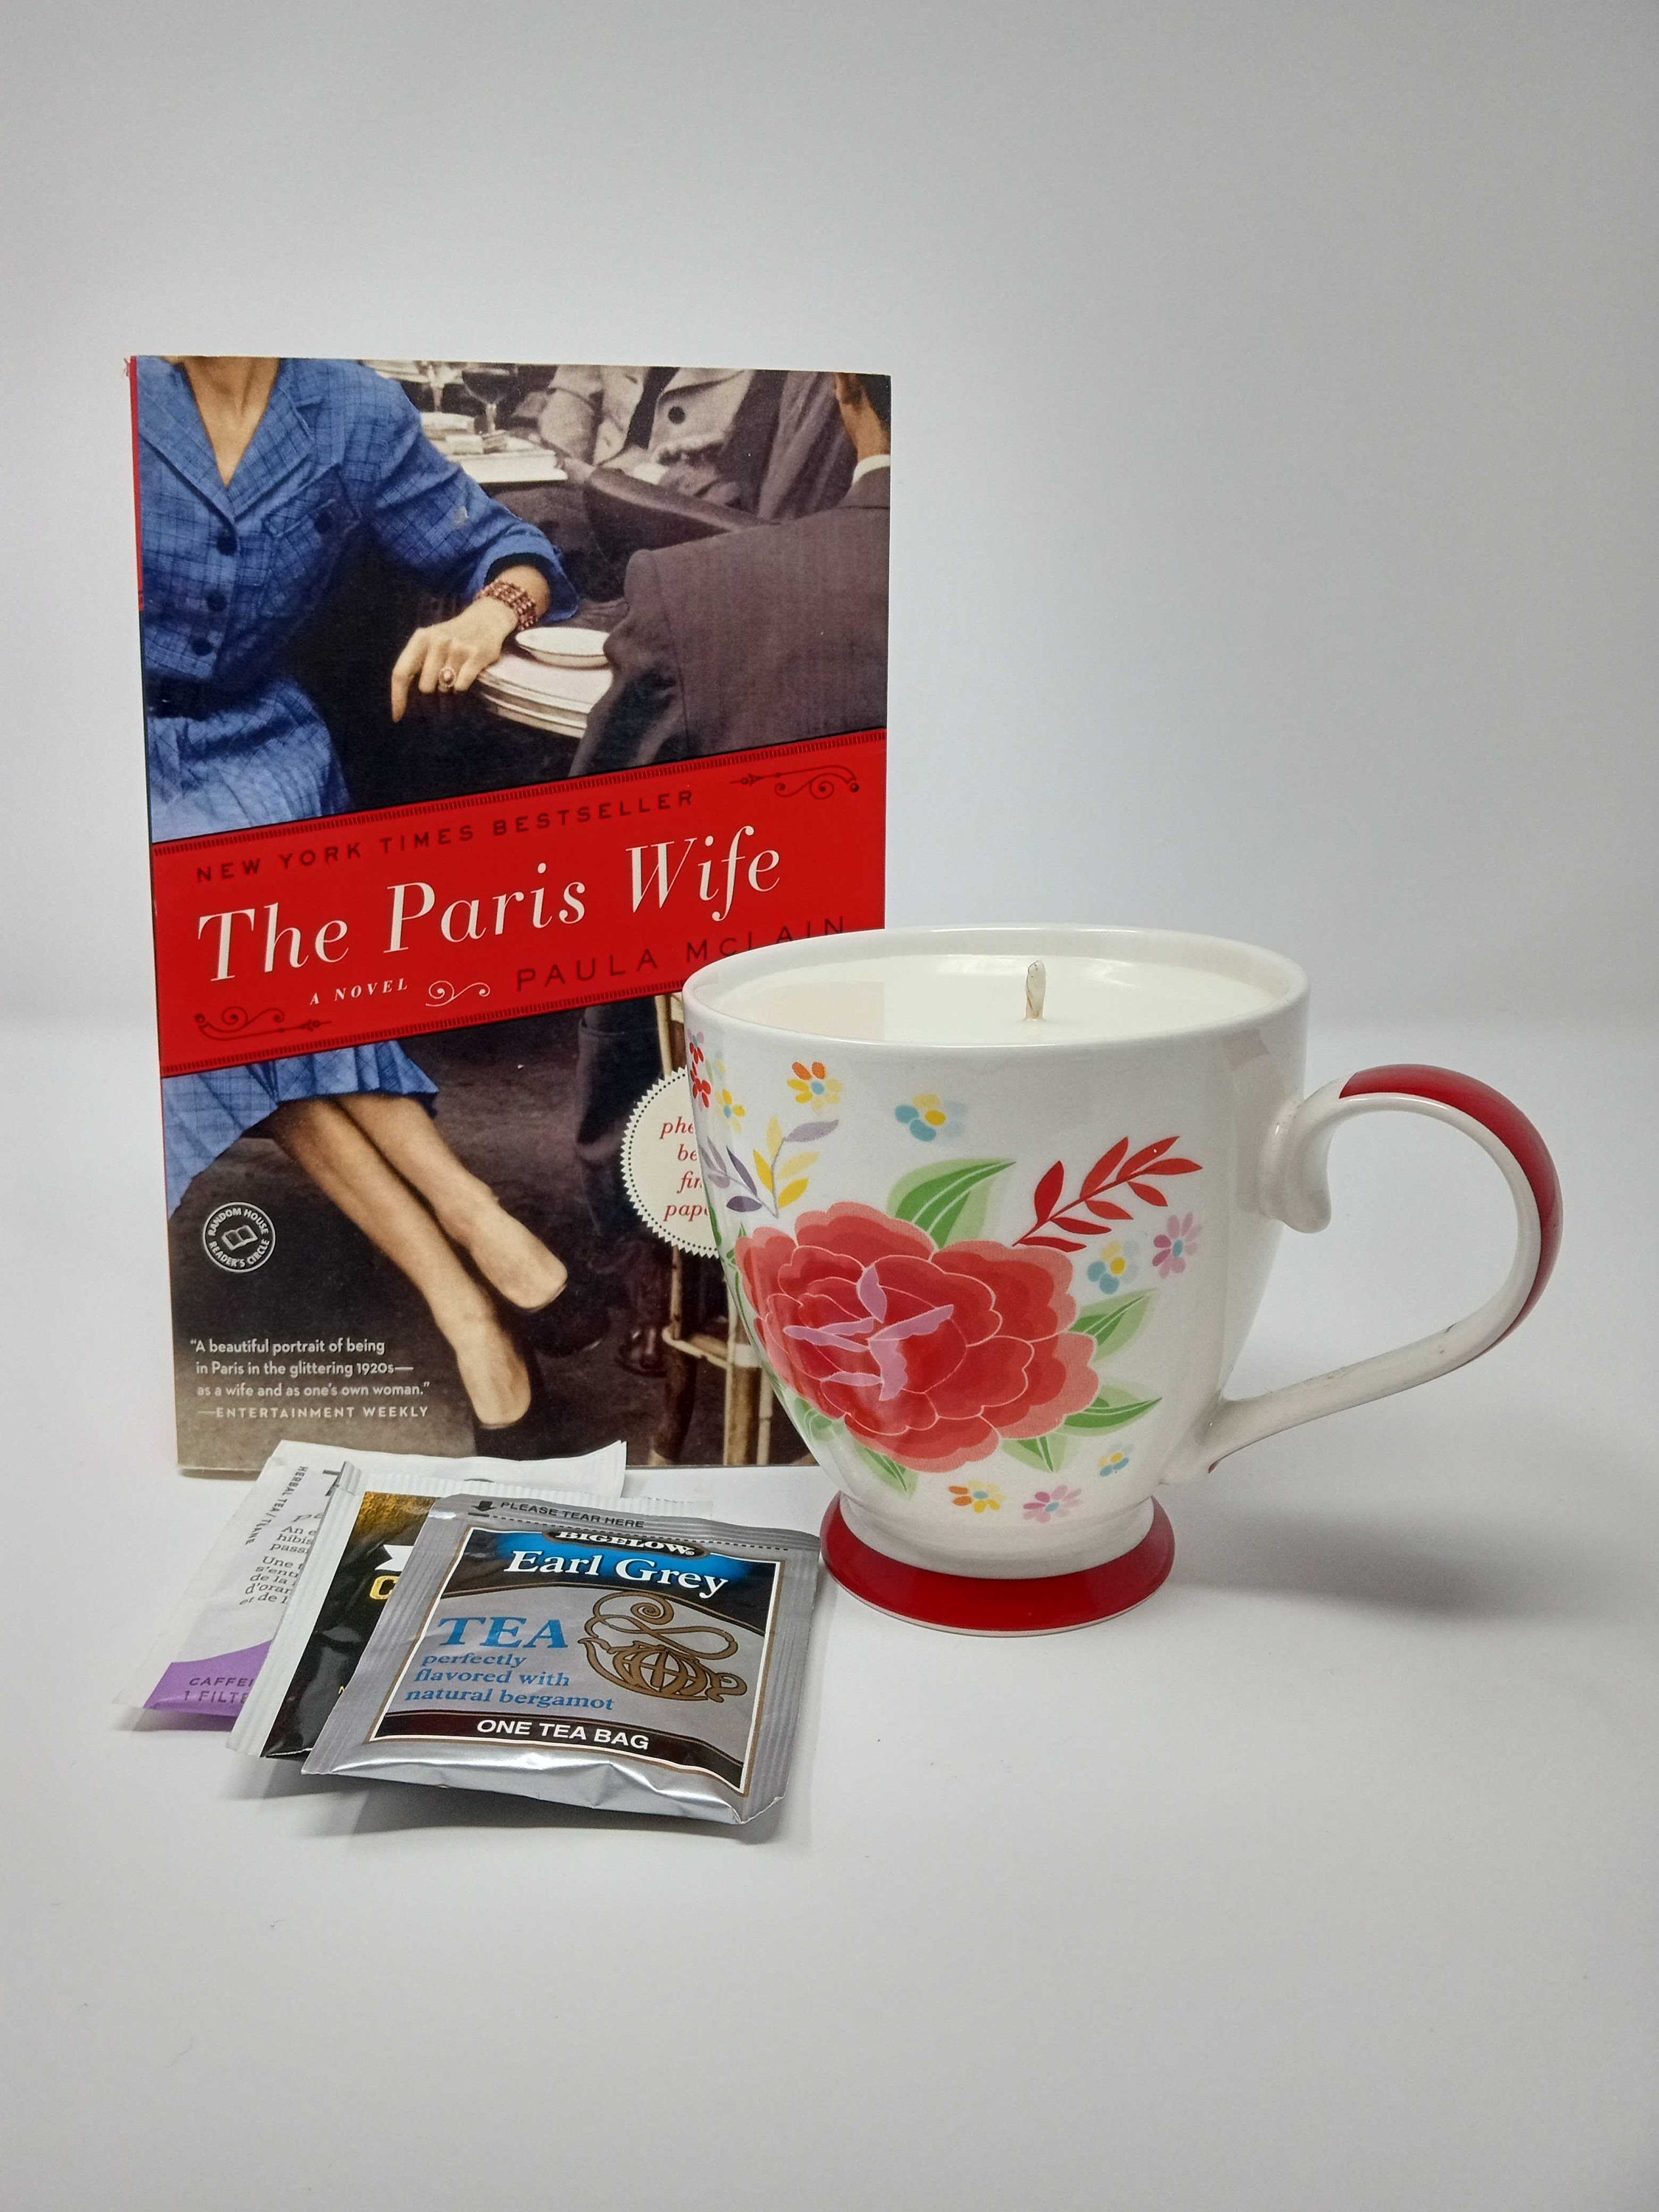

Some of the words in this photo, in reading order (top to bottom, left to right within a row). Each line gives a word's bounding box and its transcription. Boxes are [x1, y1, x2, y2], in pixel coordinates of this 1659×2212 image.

[197, 858, 261, 883] NEW
[279, 842, 361, 869] YORK
[380, 825, 475, 854] TIMES
[493, 790, 694, 836] BESTSELLER
[198, 902, 349, 981] The
[383, 863, 586, 954] Paris
[626, 825, 781, 922] Wife
[518, 949, 658, 991] PAULA
[310, 992, 320, 1006] A
[334, 978, 408, 1001] NOVEL
[208, 1208, 242, 1237] RANDOM
[243, 1209, 269, 1234] HOUSE
[209, 1241, 246, 1267] READER'S
[247, 1239, 270, 1265] CIRCLE
[209, 1338, 269, 1353] beautiful
[273, 1339, 325, 1356] portrait
[329, 1338, 344, 1352] of
[347, 1337, 385, 1355] being
[196, 1361, 208, 1374] in
[212, 1360, 245, 1374] Paris
[248, 1362, 260, 1374] in
[264, 1360, 286, 1374] the
[290, 1360, 353, 1378] glittering
[198, 1386, 211, 1396] as
[215, 1387, 222, 1396] a
[226, 1382, 254, 1397] wife
[258, 1382, 282, 1397] and
[286, 1387, 300, 1397] as
[341, 1386, 369, 1395] own
[363, 1406, 428, 1417] WEEKLY
[282, 1466, 308, 1495] HERBAL
[501, 1502, 557, 1516] PLEASE
[563, 1512, 601, 1523] TEAR
[605, 1517, 645, 1528] HERE
[262, 1556, 293, 1568] Une
[274, 1576, 288, 1584] la
[504, 1551, 603, 1576] Earl
[616, 1559, 729, 1599] Grey
[257, 1593, 277, 1601] de
[438, 1616, 568, 1648] TEA
[422, 1653, 527, 1668] perfectly
[414, 1669, 512, 1683] flavored
[519, 1672, 571, 1686] with
[184, 1691, 189, 1700] 1
[406, 1688, 491, 1702] natural
[499, 1688, 615, 1710] bergamot
[477, 1719, 532, 1735] ONE
[539, 1723, 587, 1740] TEA
[594, 1729, 650, 1750] BAG
